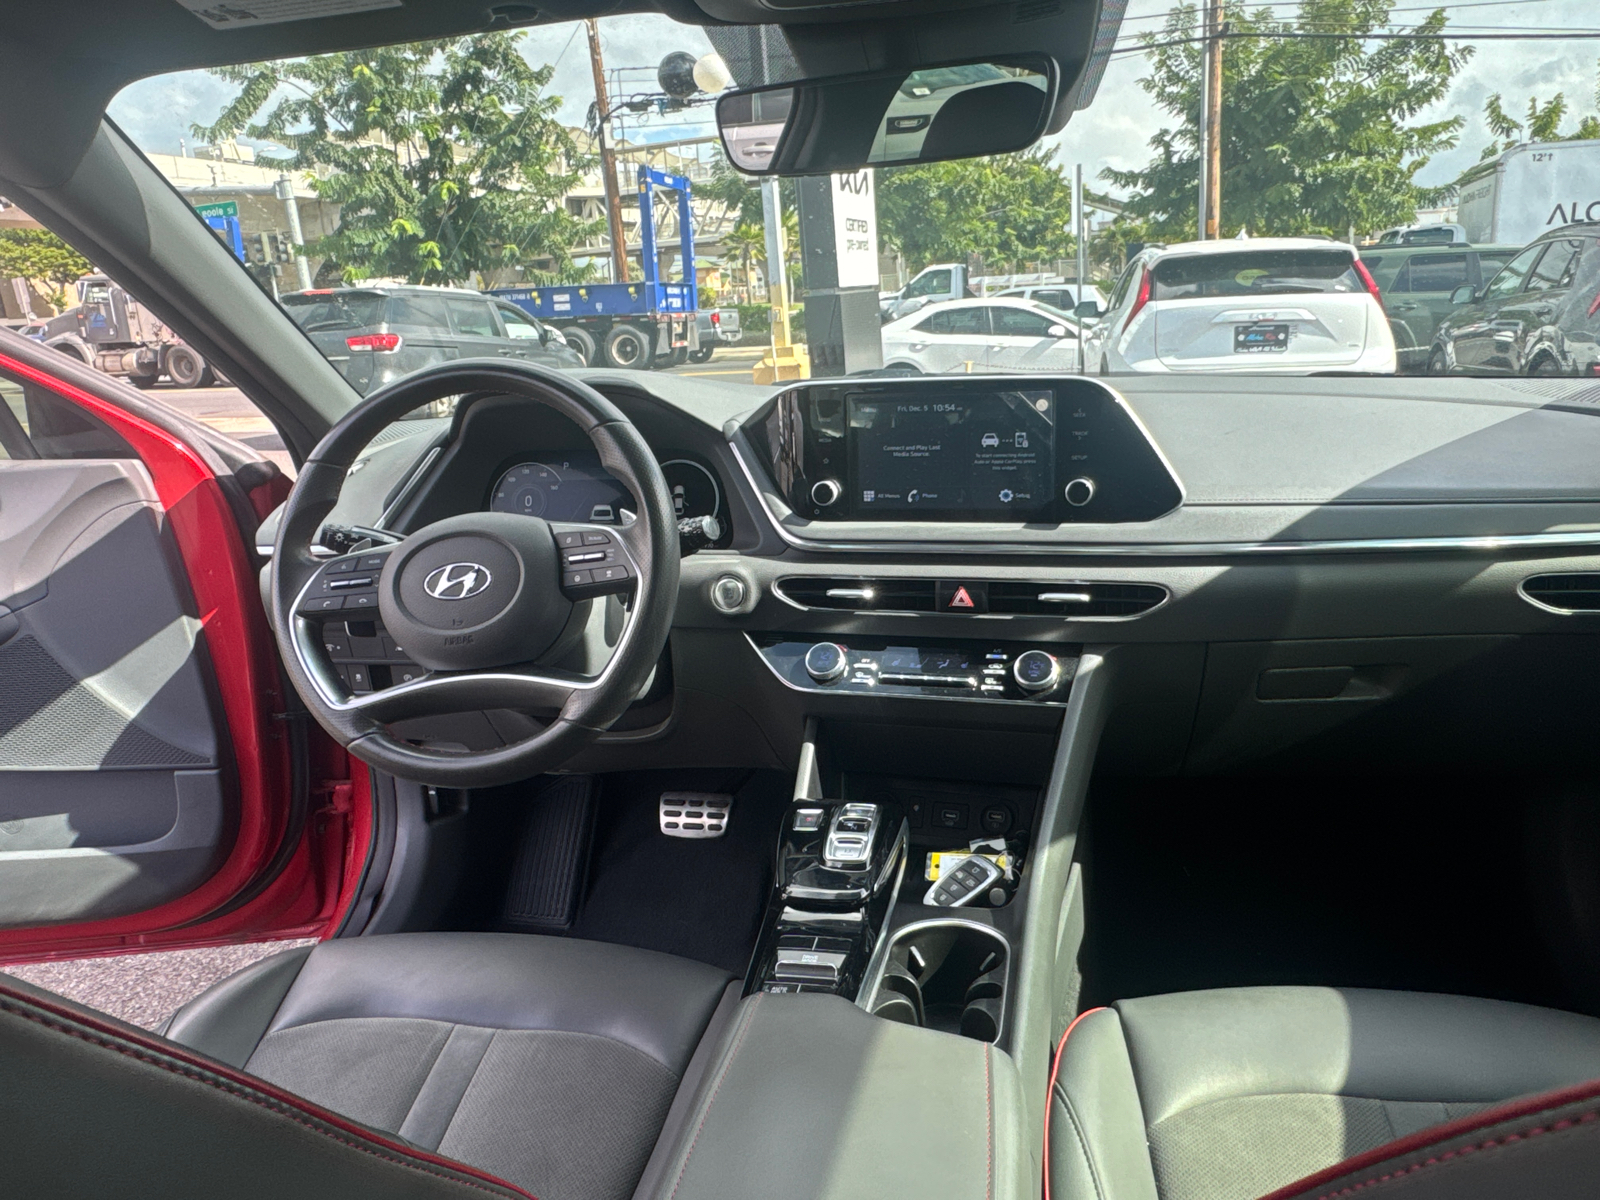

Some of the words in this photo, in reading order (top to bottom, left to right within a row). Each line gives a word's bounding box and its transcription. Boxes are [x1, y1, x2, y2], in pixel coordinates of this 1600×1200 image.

[932, 404, 956, 412] 10:54
[563, 462, 569, 470] P
[525, 495, 533, 507] 0
